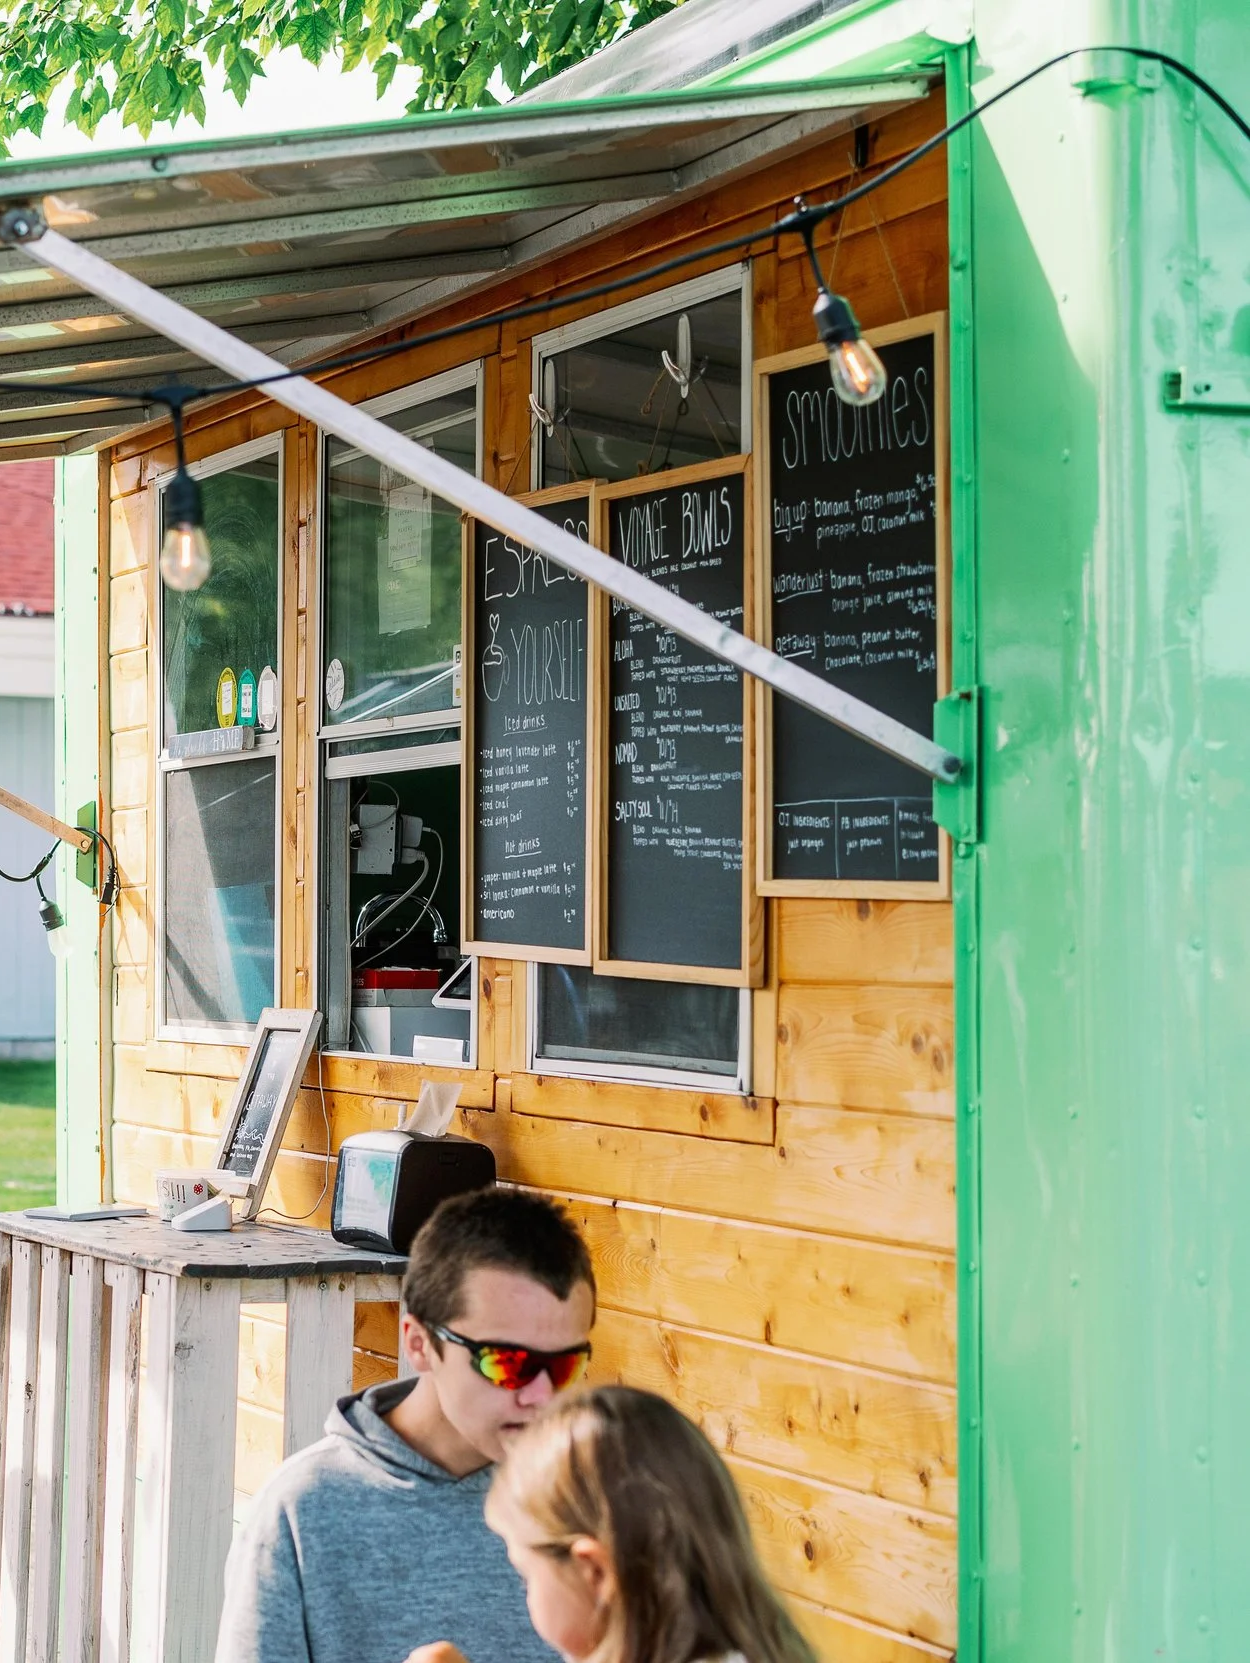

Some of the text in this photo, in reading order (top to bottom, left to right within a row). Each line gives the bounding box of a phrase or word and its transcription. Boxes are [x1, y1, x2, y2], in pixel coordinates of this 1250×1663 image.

[774, 498, 791, 542] big
[855, 489, 883, 511] frozen
[878, 515, 906, 532] coconut
[909, 510, 925, 523] milk
[619, 487, 732, 568] VOYAGE BOWLS
[485, 519, 588, 601] ESPR
[651, 565, 668, 577] BLENDS
[670, 564, 679, 573] ARE
[867, 562, 894, 584] frozen
[887, 587, 914, 603] almond
[917, 584, 933, 595] milk
[862, 629, 891, 650] peanut
[511, 619, 582, 704] YOURSELF
[614, 640, 634, 662] ALOHA
[614, 693, 640, 711] UNSALTED
[522, 714, 546, 730] drinks
[615, 742, 638, 765] NOMAD
[615, 800, 637, 823] SALTY
[637, 800, 653, 818] SOUL
[778, 812, 790, 826] OJ
[840, 816, 850, 830] PB
[505, 838, 540, 854] hot drinks
